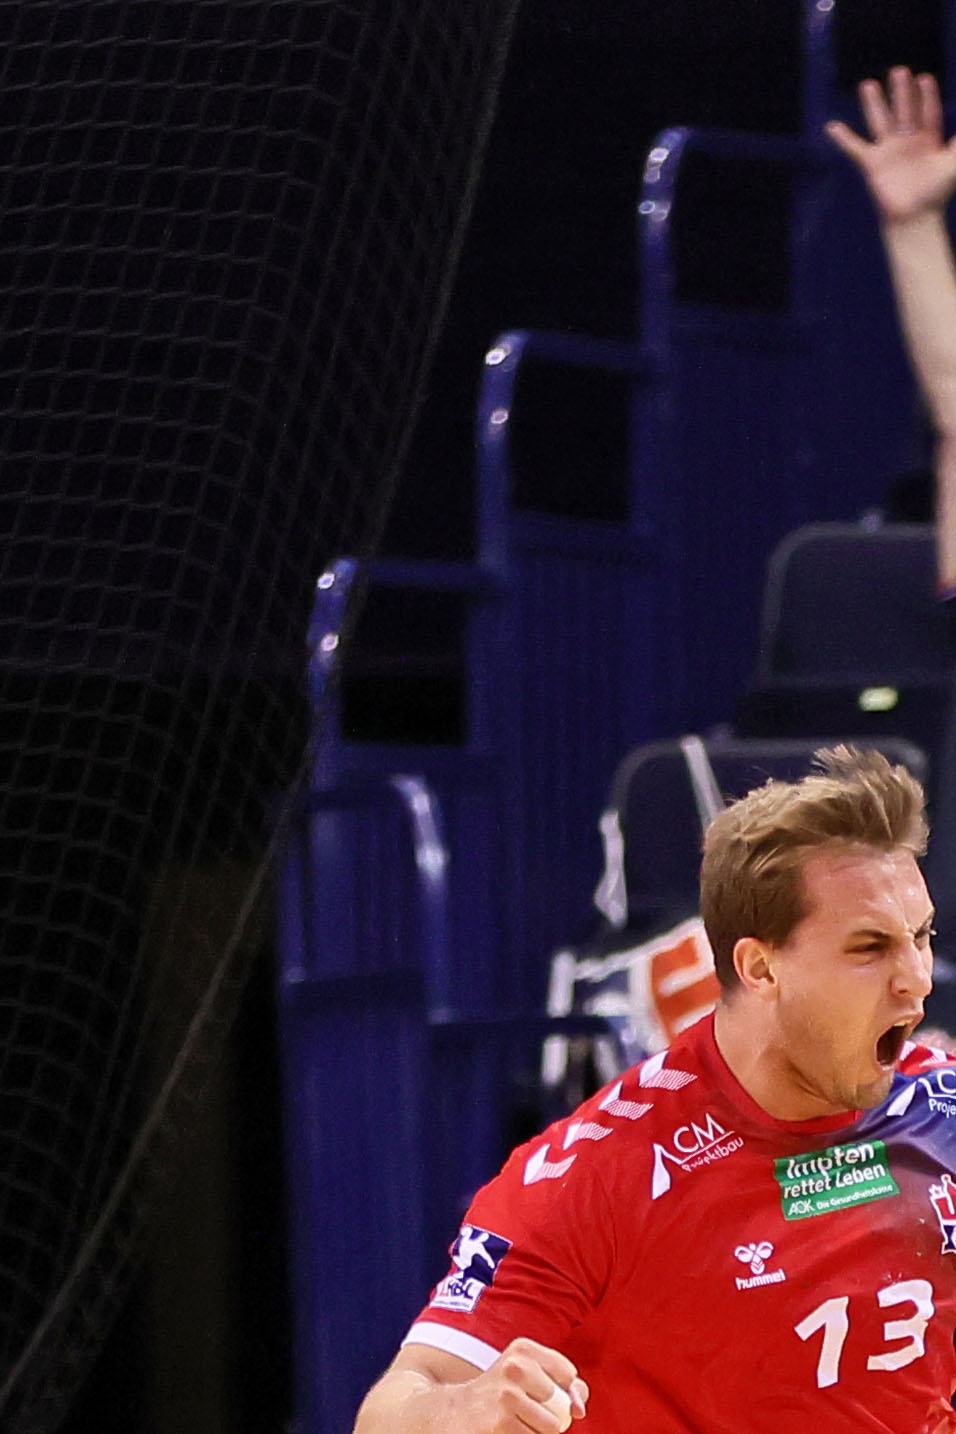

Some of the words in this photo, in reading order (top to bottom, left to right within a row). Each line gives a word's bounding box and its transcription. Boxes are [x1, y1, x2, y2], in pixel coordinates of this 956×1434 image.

[784, 1172, 832, 1200] rettet
[836, 1163, 886, 1188] Leben
[788, 1198, 816, 1216] AOK
[735, 1267, 786, 1291] hummel
[794, 1278, 936, 1389] 13
